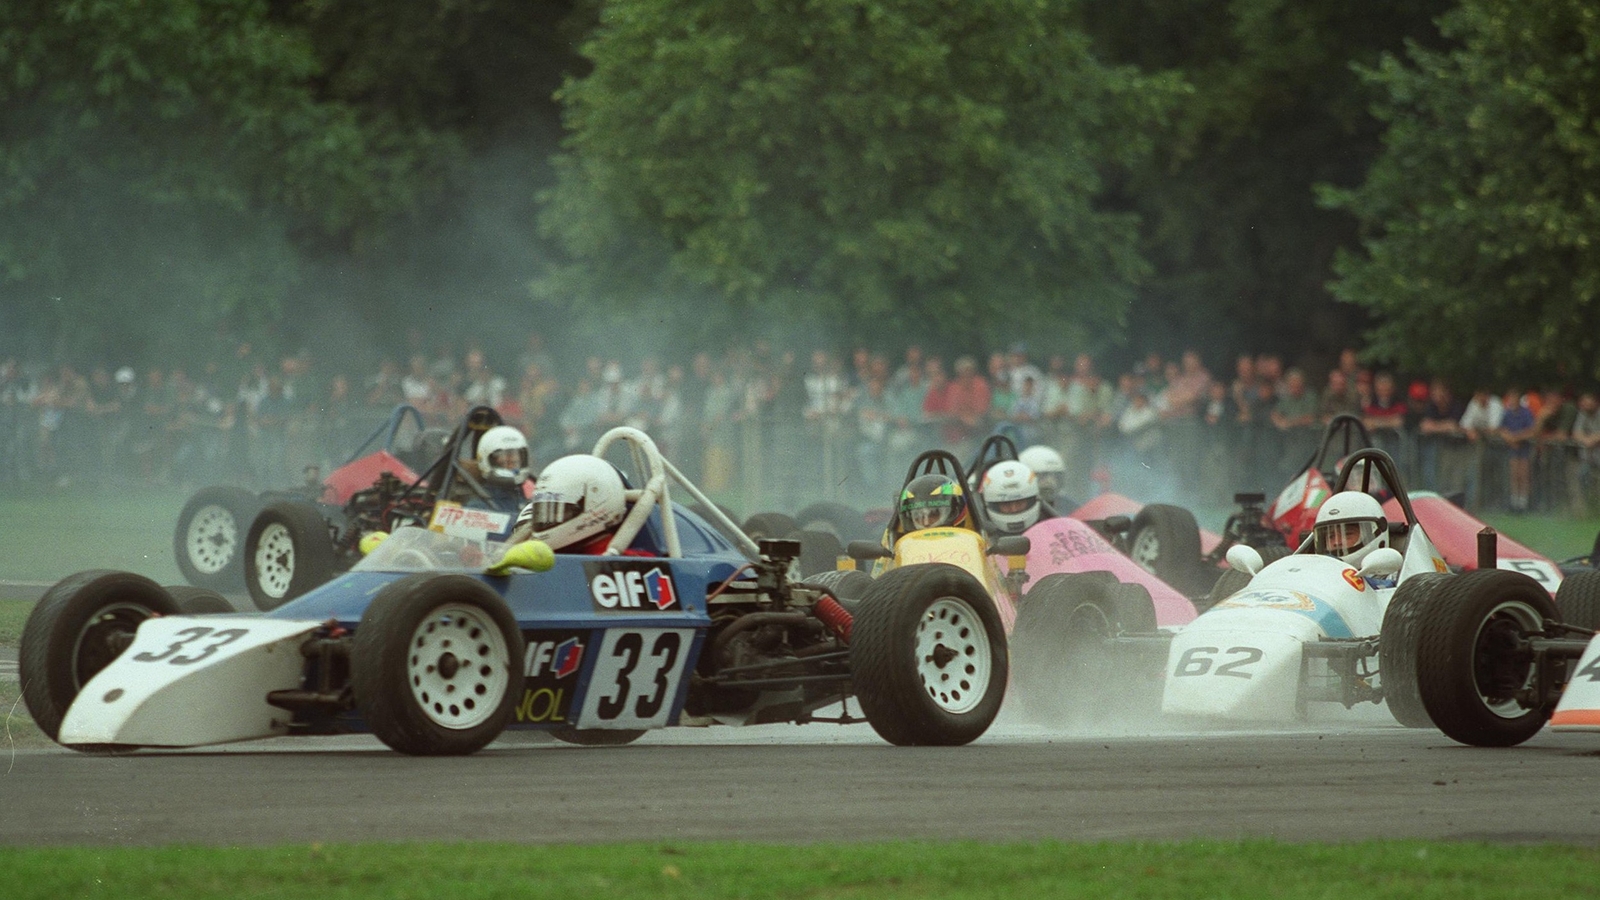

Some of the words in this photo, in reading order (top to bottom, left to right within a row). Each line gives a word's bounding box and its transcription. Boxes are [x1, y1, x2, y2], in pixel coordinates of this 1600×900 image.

[592, 571, 645, 608] elf
[132, 626, 250, 665] 33
[524, 641, 555, 677] lf
[1173, 646, 1264, 680] 62
[597, 632, 681, 720] 33
